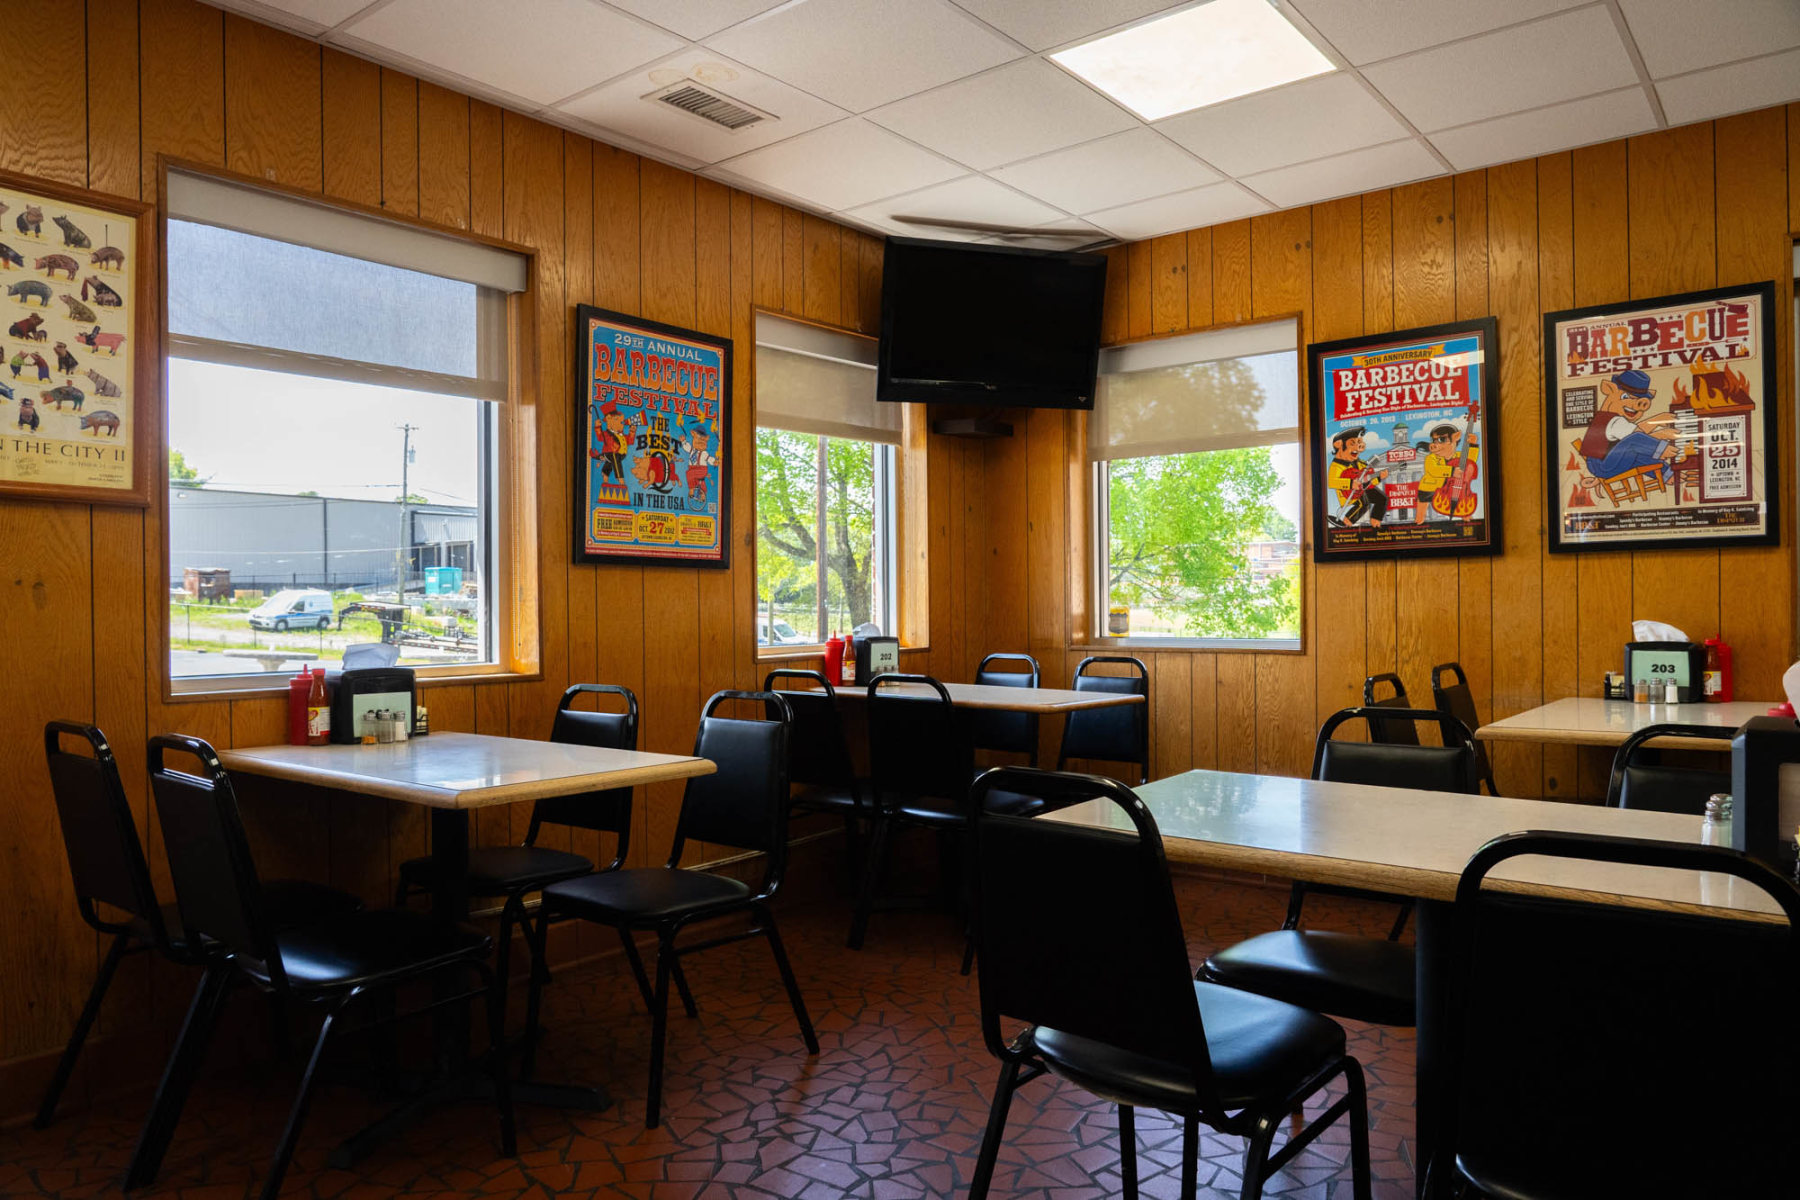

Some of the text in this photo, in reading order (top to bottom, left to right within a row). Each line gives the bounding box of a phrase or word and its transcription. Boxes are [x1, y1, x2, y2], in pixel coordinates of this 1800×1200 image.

[1591, 321, 1626, 330] ANNUAL
[1567, 307, 1749, 363] BARBECUE
[614, 333, 702, 361] 29TH ANNUAL
[1364, 350, 1434, 367] 30TH ANNIVERSARY
[1567, 343, 1749, 377] FESTIVAL
[595, 342, 718, 402] BARBECUE
[1339, 356, 1462, 391] BARBECUE
[594, 383, 717, 419] FESTIVAL
[1345, 379, 1460, 412] FESTIVAL
[1566, 412, 1594, 420] LEXINGTON
[650, 416, 670, 433] THE
[1708, 422, 1740, 431] SATURDAY
[1711, 430, 1739, 442] OCT.
[12, 440, 52, 455] THE
[61, 443, 105, 460] CITY
[114, 449, 125, 462] II
[635, 434, 682, 455] BEST
[1711, 445, 1738, 457] 25
[1712, 458, 1737, 470] 2014
[633, 492, 685, 511] IN THE USA
[1390, 496, 1415, 508] BB&T
[597, 519, 612, 530] FREE
[645, 514, 670, 524] SATURDAY
[649, 521, 665, 534] 27
[880, 653, 892, 661] 202
[1651, 663, 1676, 673] 203
